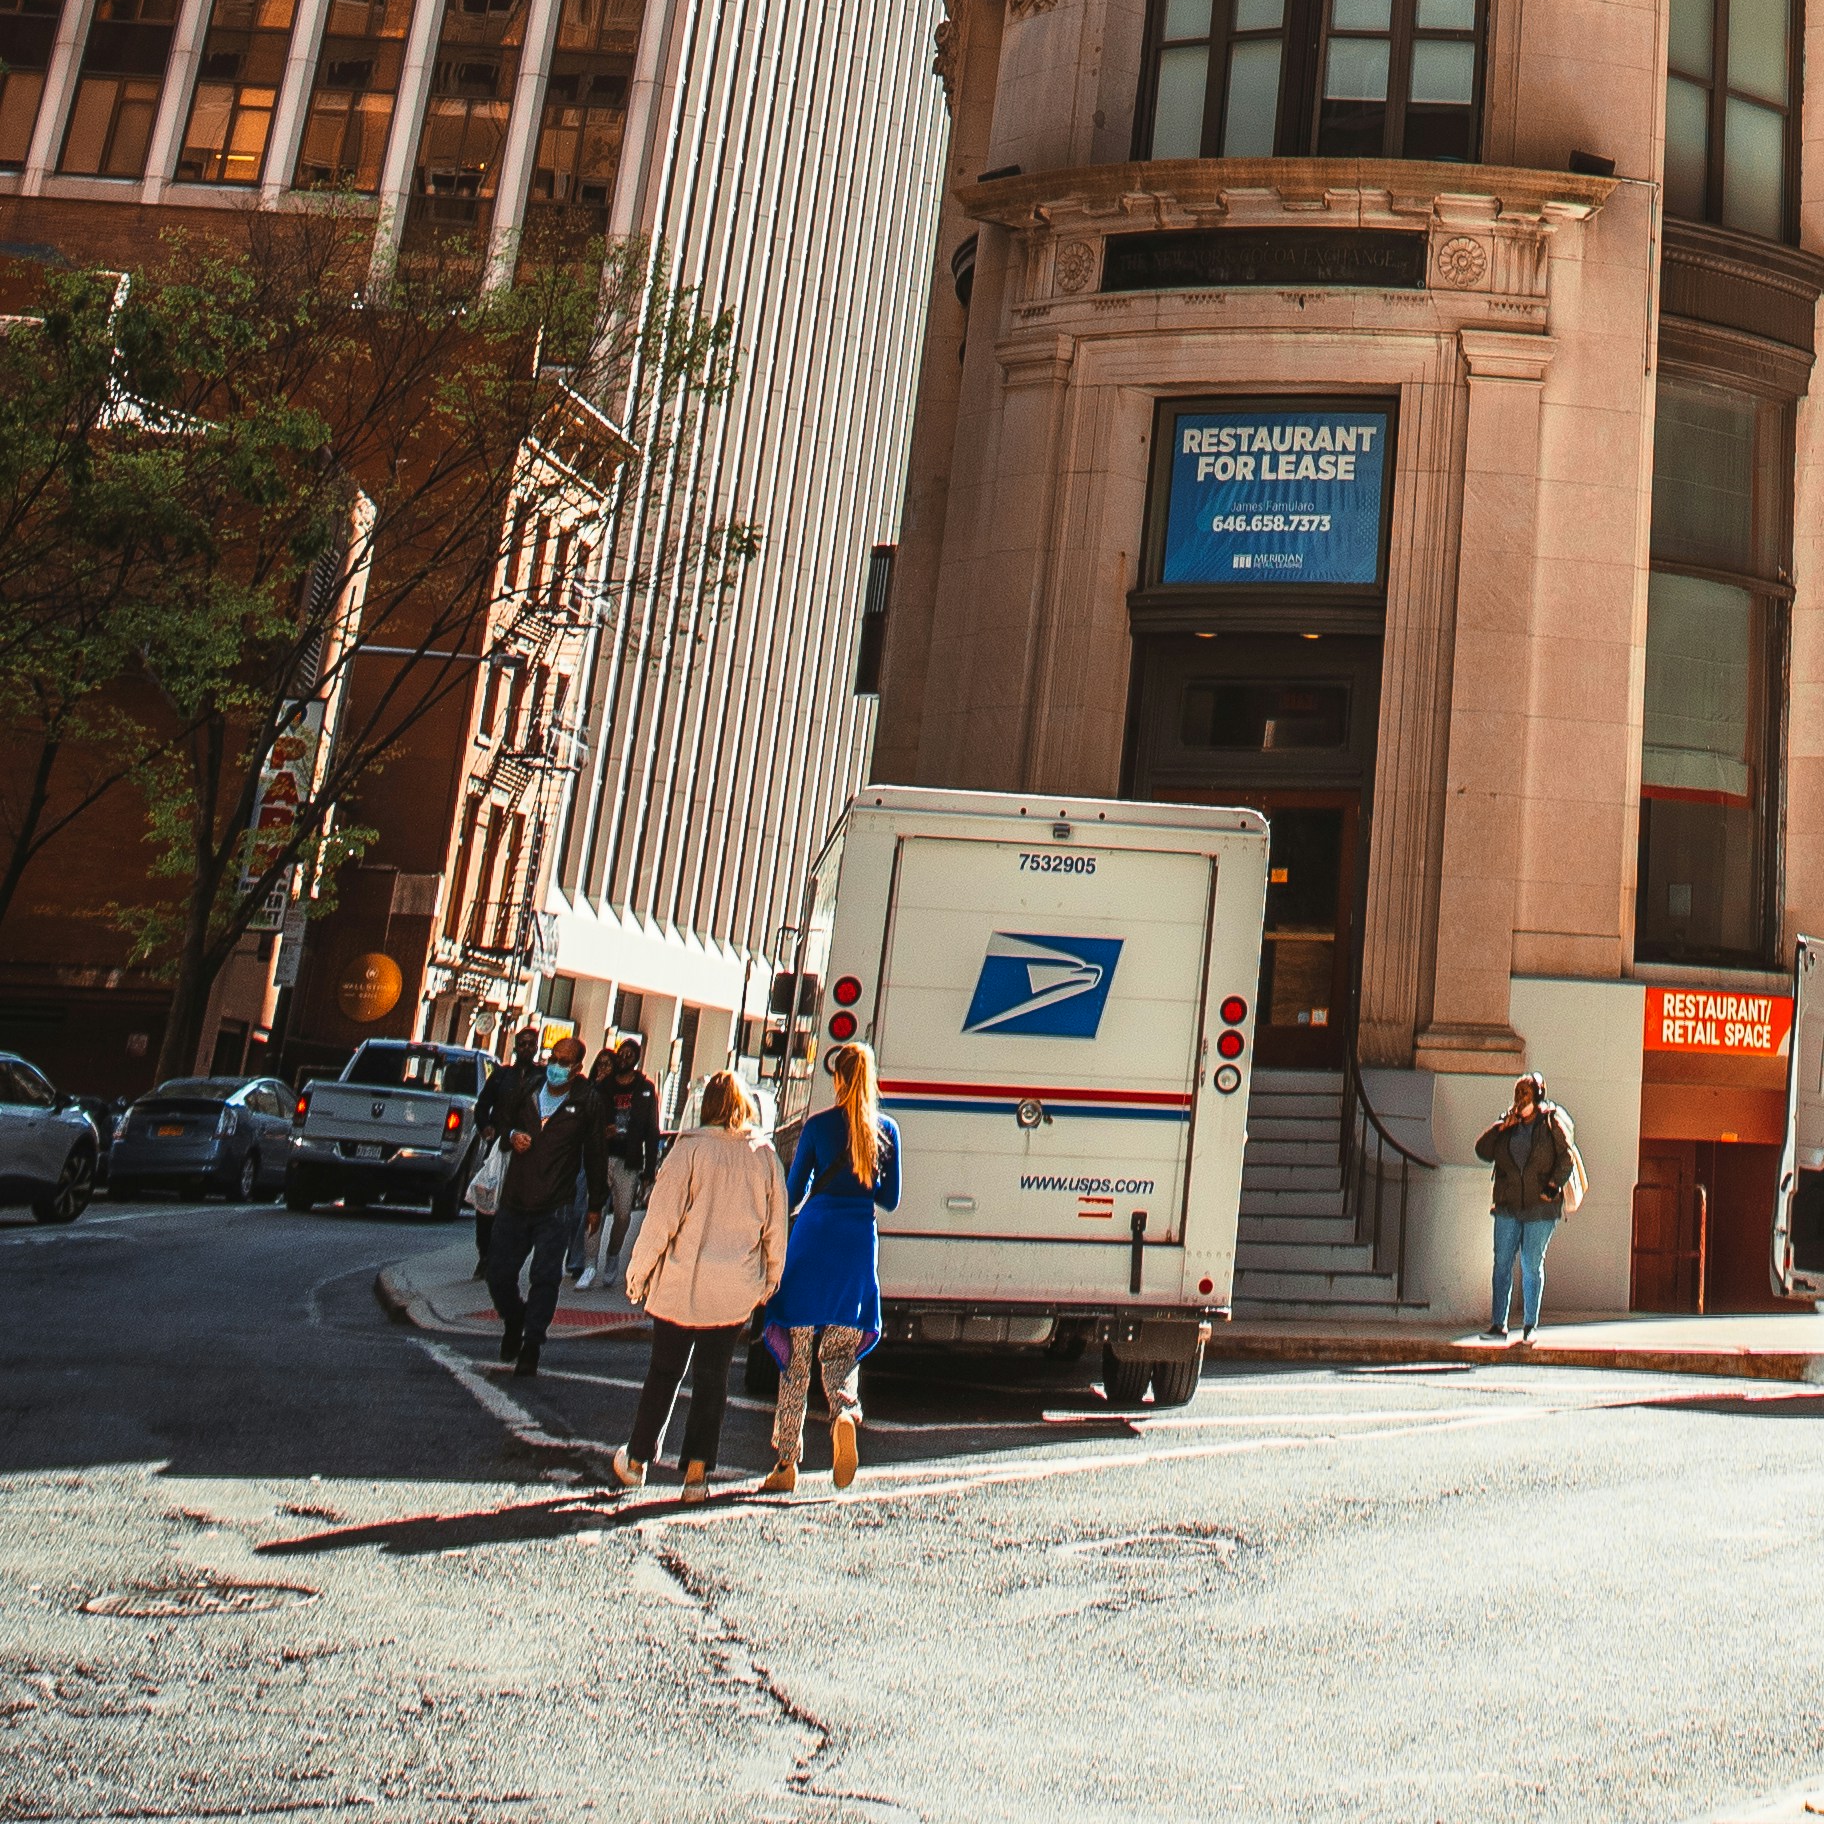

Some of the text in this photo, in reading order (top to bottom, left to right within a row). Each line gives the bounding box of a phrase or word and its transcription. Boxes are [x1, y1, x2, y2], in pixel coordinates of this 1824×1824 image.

[1182, 425, 1377, 454] RESTAURANT
[1196, 453, 1356, 482] FOR LEASE
[1230, 500, 1315, 513] James Famularo
[1211, 514, 1332, 533] 646.658.7373
[1019, 853, 1097, 875] 7532905
[1663, 992, 1773, 1025] RESTAURANT/
[1662, 1019, 1772, 1049] RETAIL SPACE
[1019, 1174, 1155, 1196] www.usps.com
